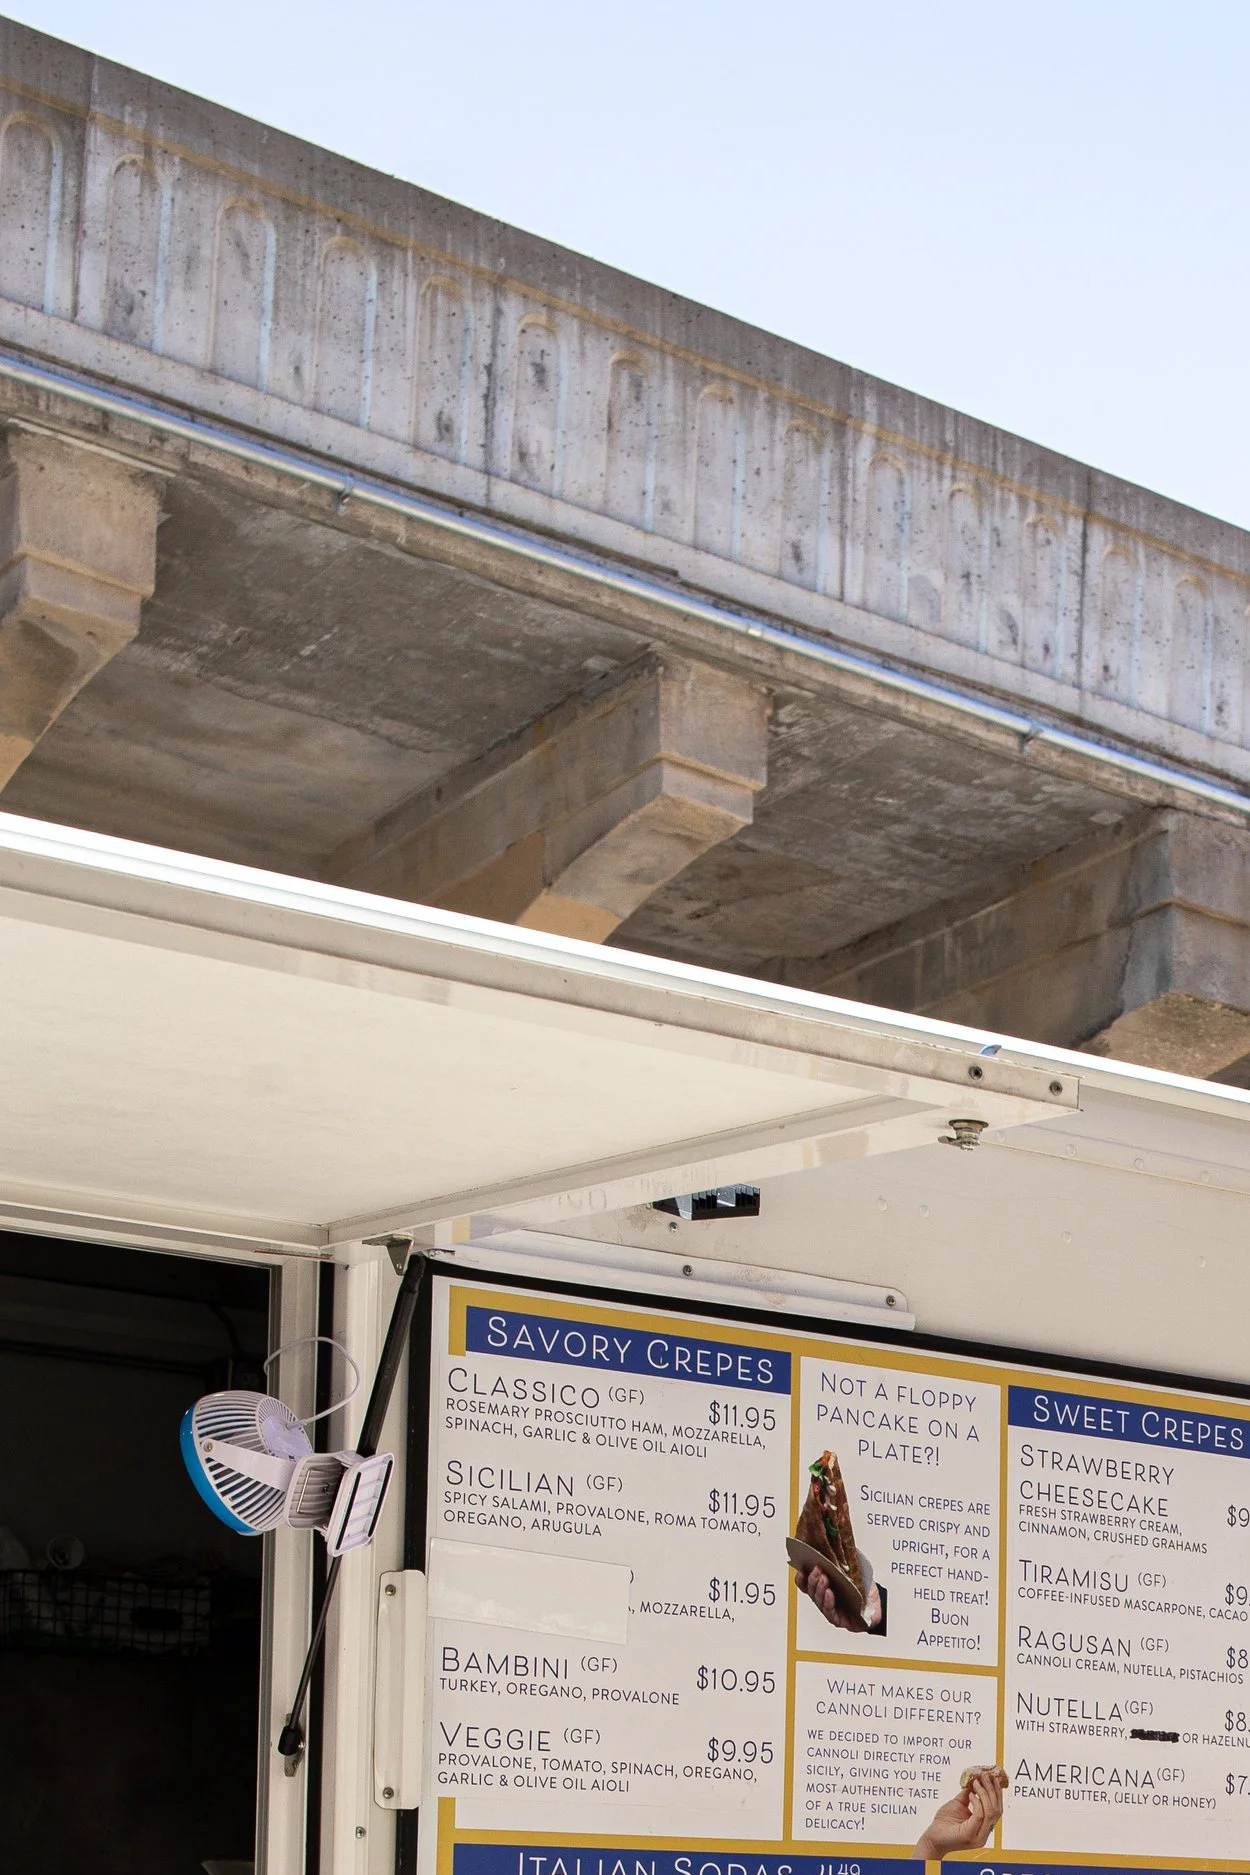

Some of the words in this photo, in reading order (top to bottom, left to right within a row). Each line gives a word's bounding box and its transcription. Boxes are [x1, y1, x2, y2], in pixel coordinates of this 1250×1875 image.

[488, 1317, 631, 1363] SAVORY
[647, 1340, 773, 1383] CREPES
[449, 1368, 599, 1408] CLASSICO
[609, 1386, 644, 1405] (GF)
[822, 1372, 866, 1397] NOT
[875, 1383, 888, 1400] A
[898, 1386, 976, 1412] FLOPPY
[447, 1398, 529, 1418] ROSEMARY
[535, 1408, 626, 1430] PROSCIUTTO
[632, 1420, 667, 1438] HAM,
[672, 1425, 765, 1450] MOZZARELLA,
[709, 1400, 775, 1431] $11.95
[818, 1404, 918, 1434] PANCAKE
[929, 1420, 957, 1439] ON
[967, 1425, 979, 1442] A
[1034, 1395, 1130, 1433] SWEET
[1142, 1412, 1243, 1450] CREPES
[859, 1439, 939, 1466] PLATE?!
[1021, 1444, 1174, 1485] STRAWBERRY
[447, 1460, 573, 1497] SICILIAN
[587, 1474, 622, 1492] (GF)
[444, 1491, 487, 1506] SPICY
[493, 1496, 550, 1515] SALAMI,
[557, 1502, 649, 1525] PROVALONE,
[655, 1512, 696, 1528] ROMA
[701, 1517, 760, 1536] TOMATO,
[709, 1488, 775, 1518] $11.95
[1020, 1480, 1168, 1517] CHEESECAKE
[444, 1510, 525, 1531] OREGANO,
[531, 1518, 601, 1536] ARUGULA
[1020, 1504, 1056, 1519] FRESH
[1061, 1510, 1136, 1528] STRAWBERRY
[1140, 1520, 1182, 1536] CREAM,
[1019, 1521, 1089, 1541] CINNAMON,
[1094, 1530, 1148, 1546] CRUSHED
[1152, 1537, 1207, 1554] GRAHAMS
[1019, 1559, 1127, 1592] TIRAMISU
[1138, 1573, 1166, 1588] (GF)
[709, 1577, 775, 1606] $11.95
[1018, 1587, 1120, 1607] COFFEE-INFUSED
[1124, 1599, 1205, 1618] MASCARPONE,
[1209, 1608, 1248, 1621] CACAO
[640, 1601, 734, 1622] MOZZARELLA,
[1019, 1626, 1130, 1657] RAGUSAN
[1141, 1637, 1168, 1652] (GF)
[443, 1647, 567, 1679] BAMBINI
[581, 1656, 617, 1673] (GF)
[1017, 1653, 1071, 1668] CANNOLI
[1076, 1659, 1119, 1674] CREAM,
[1124, 1663, 1175, 1679] NUTELLA,
[1180, 1668, 1243, 1684] PISTACHIOS
[440, 1678, 500, 1696] TURKEY,
[506, 1682, 586, 1701] OREGANO,
[592, 1688, 679, 1705] PROVALONE
[697, 1665, 775, 1693] $10.95
[827, 1679, 875, 1696] WHAT
[882, 1685, 933, 1700] MAKES
[941, 1690, 971, 1703] OUR
[817, 1701, 886, 1718] CANNOLI
[894, 1707, 981, 1724] DIFFERENT?
[440, 1722, 550, 1751] VEGGIE
[564, 1728, 600, 1744] (GF)
[1016, 1719, 1044, 1732] WITH
[1049, 1722, 1127, 1740] STRAWBERRY,
[1183, 1733, 1198, 1744] OR
[708, 1737, 773, 1764] $9.95
[439, 1753, 536, 1772] PROVALONE,
[542, 1758, 605, 1775] TOMATO,
[612, 1762, 677, 1779] SPINACH,
[683, 1766, 756, 1783] OREGANO,
